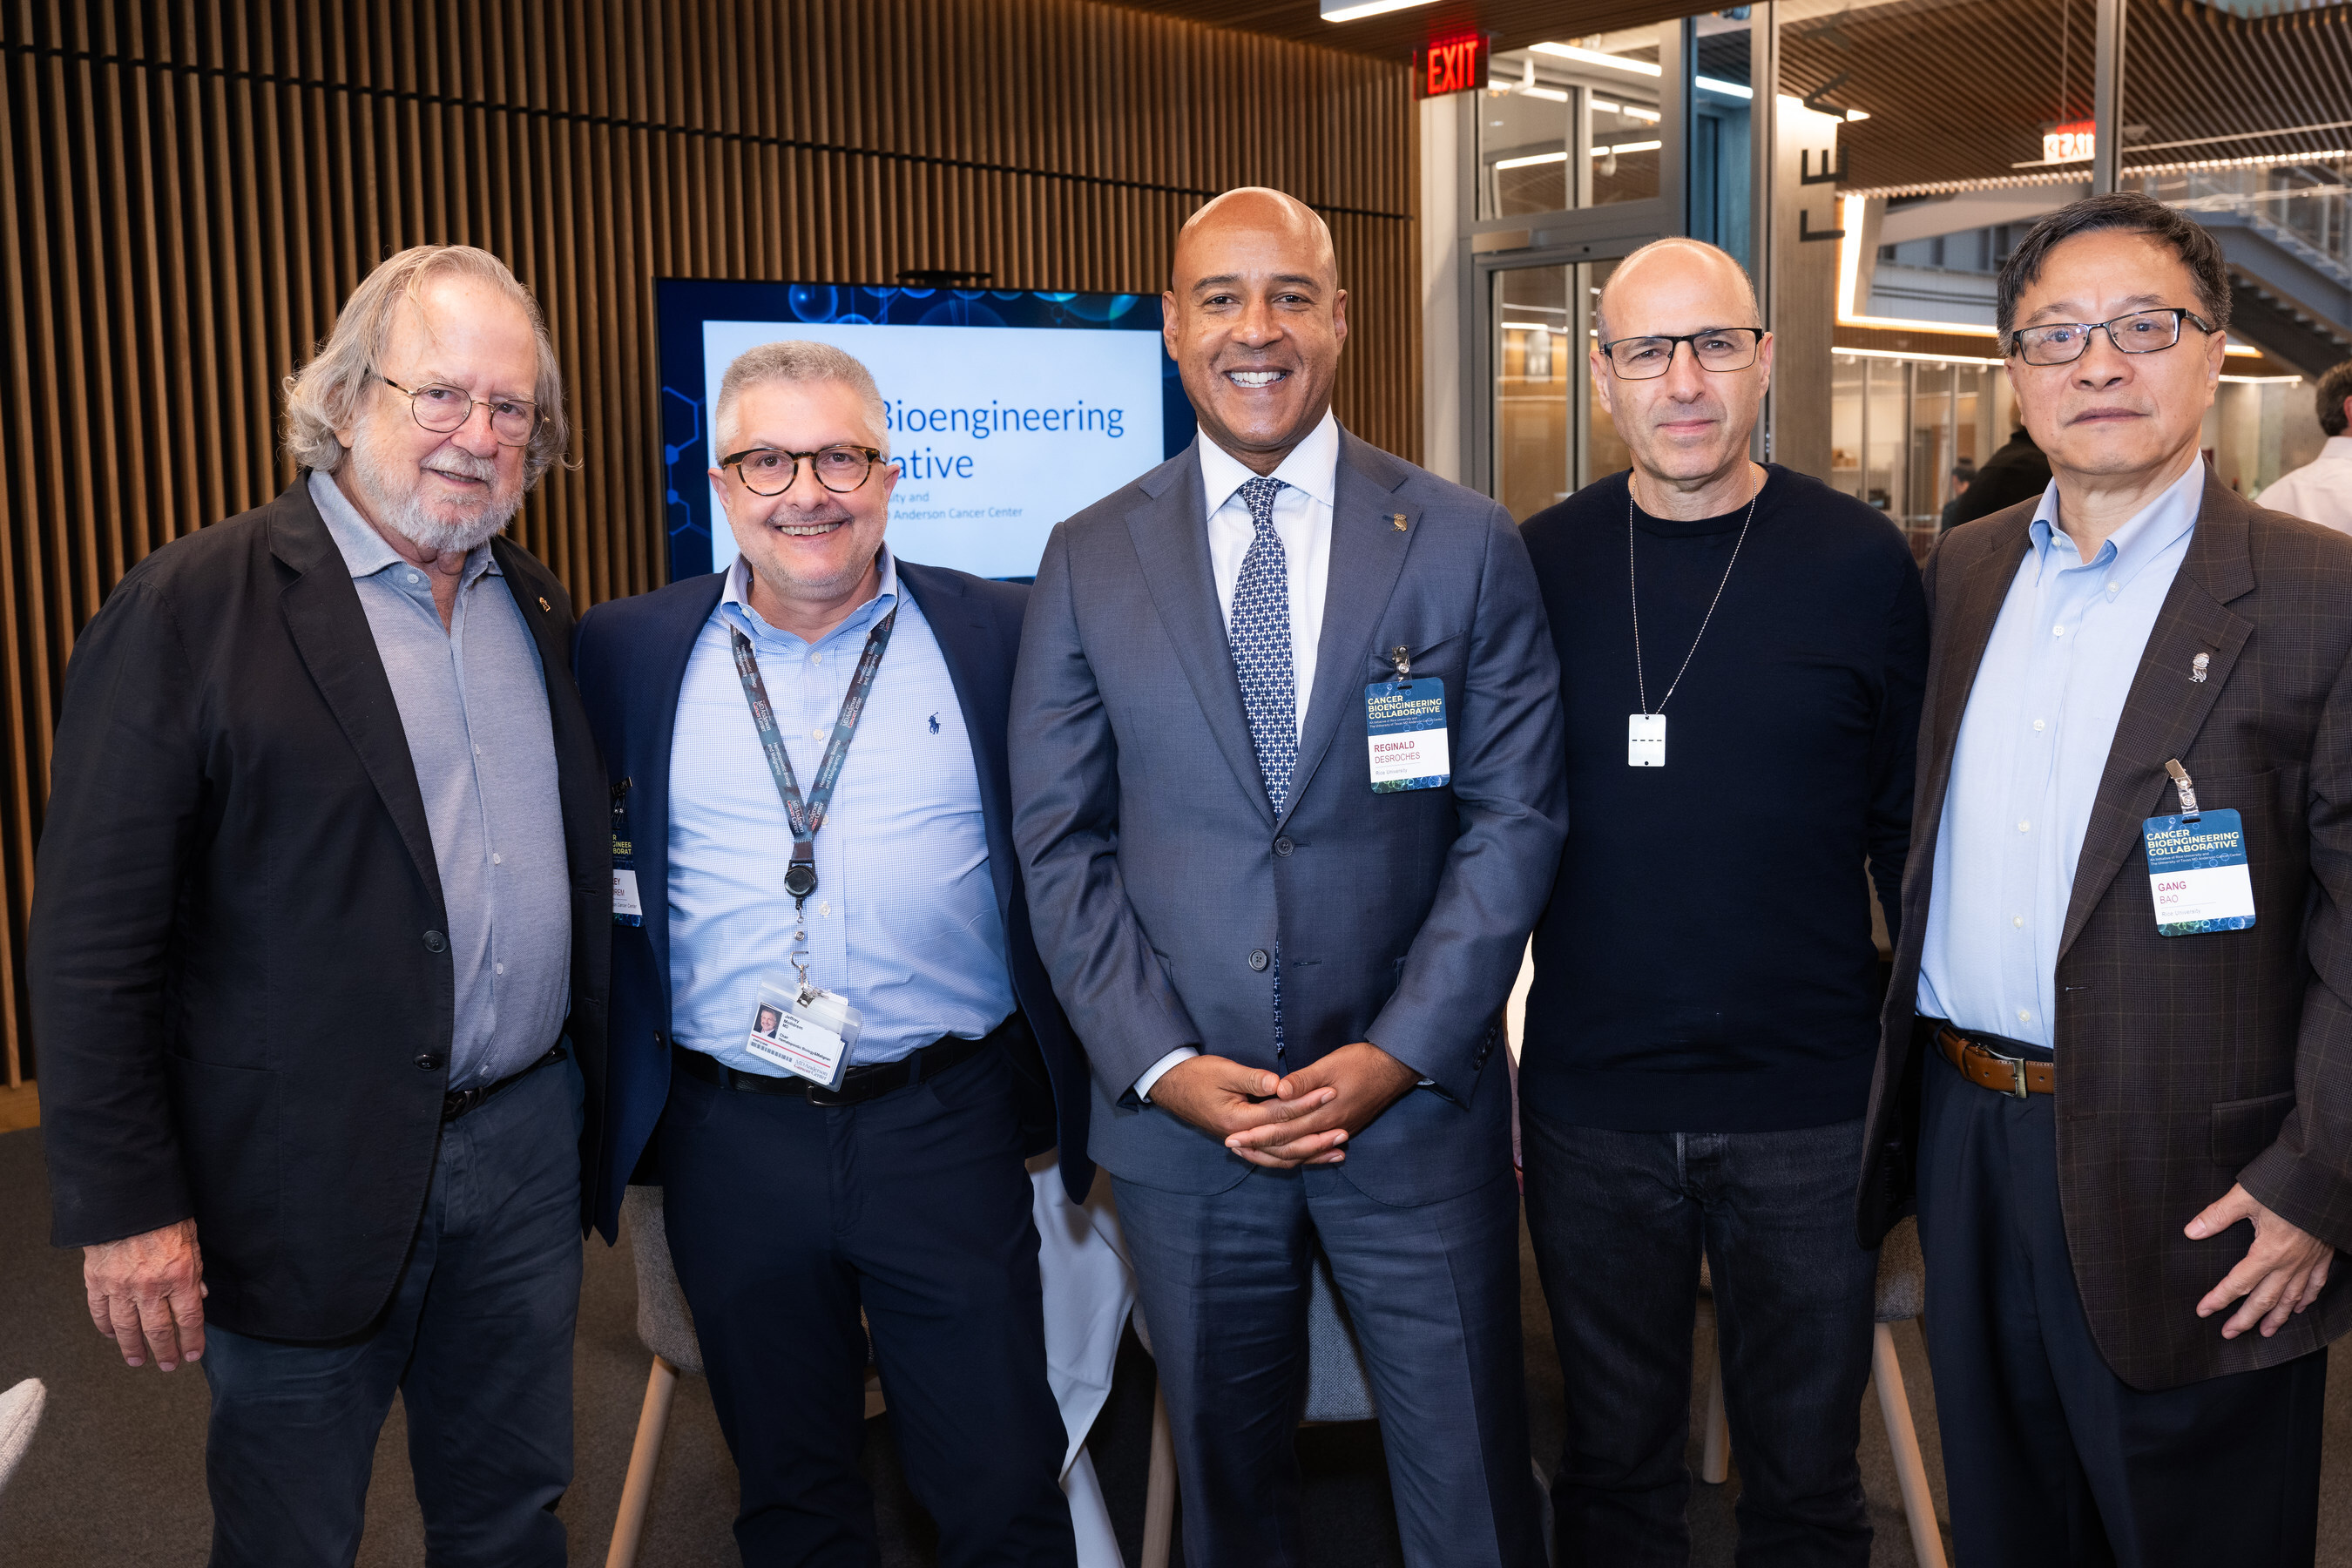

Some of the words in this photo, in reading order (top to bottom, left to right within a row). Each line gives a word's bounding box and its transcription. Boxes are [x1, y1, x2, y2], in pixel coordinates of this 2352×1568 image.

[1428, 40, 1478, 94] EXIT
[2058, 132, 2095, 159] EXI
[909, 492, 929, 503] and
[894, 508, 946, 521] Anderson
[949, 508, 985, 519] Cancer
[988, 507, 1023, 518] Center
[857, 655, 871, 685] Hematopoietic
[868, 640, 879, 655] Biology
[866, 654, 879, 677] Malignancy
[853, 697, 862, 713] Center
[1368, 695, 1403, 705] CANCER
[1369, 698, 1442, 713] BIOENGINEERING
[1369, 706, 1440, 720] COLLABORATIVE
[1374, 740, 1415, 753] REGINALD
[770, 752, 781, 775] Malignancy
[774, 742, 787, 772] Hematopoietic
[819, 755, 834, 787] Hematopoietic
[831, 740, 841, 755] Biology
[1375, 751, 1421, 764] DESROCHES
[828, 754, 841, 781] Malignancy
[791, 816, 800, 834] Center
[2146, 829, 2190, 841] CANCER
[2147, 831, 2240, 848] BIOENGINEERING
[2148, 840, 2238, 856] COLLABORATIVE
[2158, 881, 2186, 892] GANG
[2159, 895, 2179, 904] BAO
[785, 1014, 800, 1024] Jeffrey
[811, 1070, 827, 1080] Center
